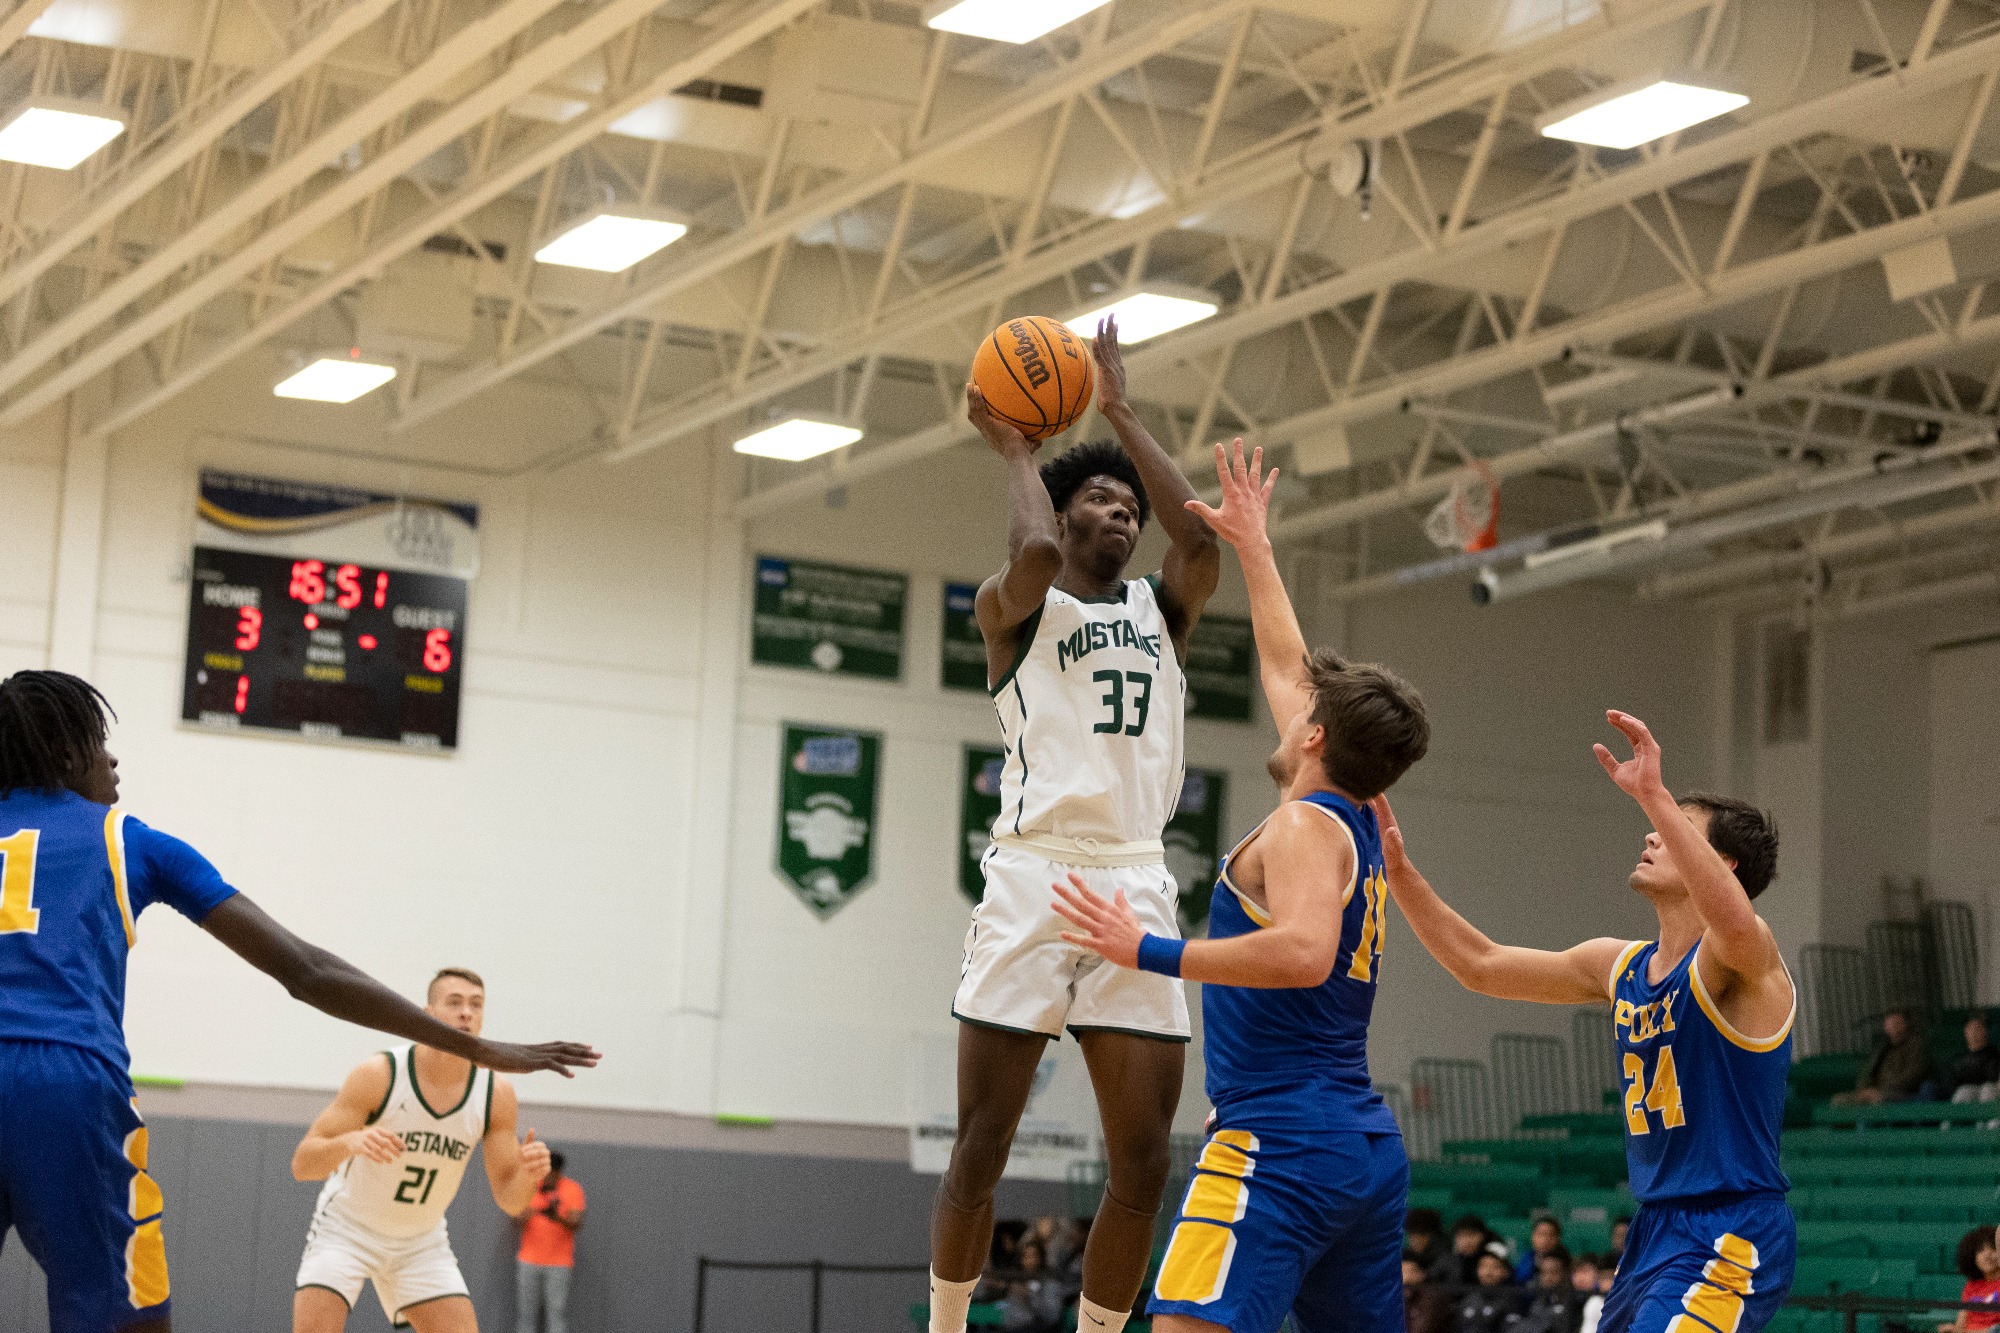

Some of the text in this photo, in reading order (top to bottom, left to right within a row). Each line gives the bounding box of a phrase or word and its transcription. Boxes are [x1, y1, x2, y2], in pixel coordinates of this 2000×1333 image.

[1008, 320, 1051, 391] Wilson
[202, 582, 261, 609] HOME
[234, 605, 263, 651] 3
[423, 626, 453, 673] 6
[233, 673, 250, 715] 1
[1093, 669, 1152, 737] 33
[1614, 988, 1680, 1043] POLY
[1623, 1044, 1687, 1136] 24
[393, 1165, 439, 1205] 21
